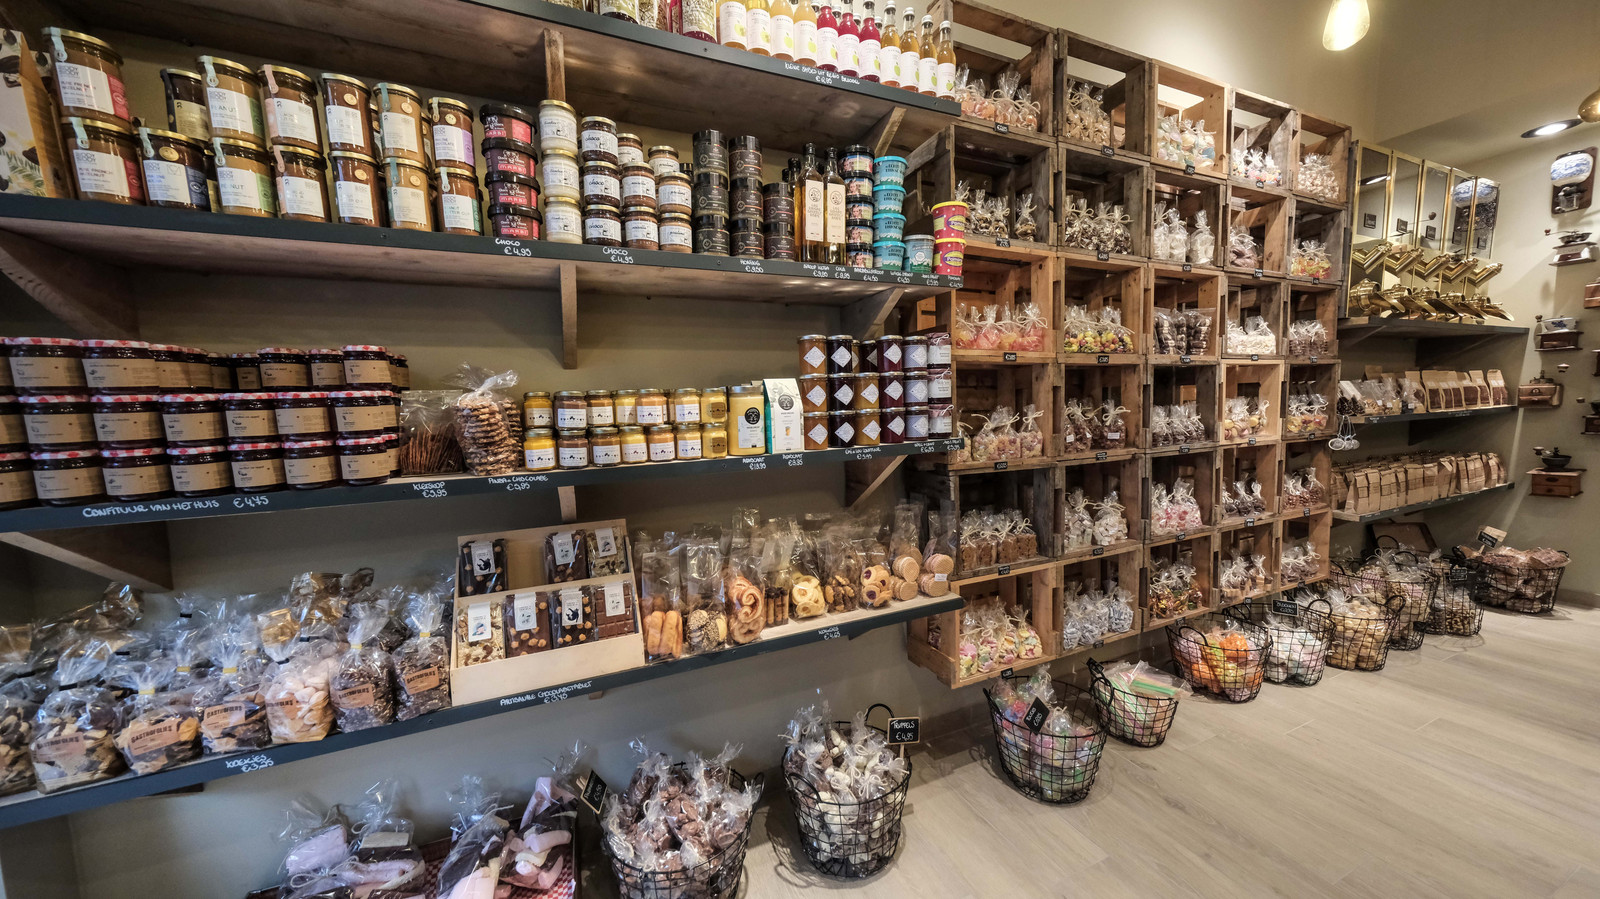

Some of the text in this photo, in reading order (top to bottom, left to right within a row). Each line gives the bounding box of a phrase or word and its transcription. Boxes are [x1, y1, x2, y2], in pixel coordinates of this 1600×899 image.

[495, 238, 520, 247] CHOCO
[602, 246, 628, 256] CHOCO
[82, 503, 148, 518] CONFITUUR
[150, 503, 171, 512] VAN
[172, 501, 193, 511] HET
[193, 499, 220, 509] HUIS
[131, 725, 173, 743] GASTROFOLIES
[225, 754, 267, 768] KOEKJES
